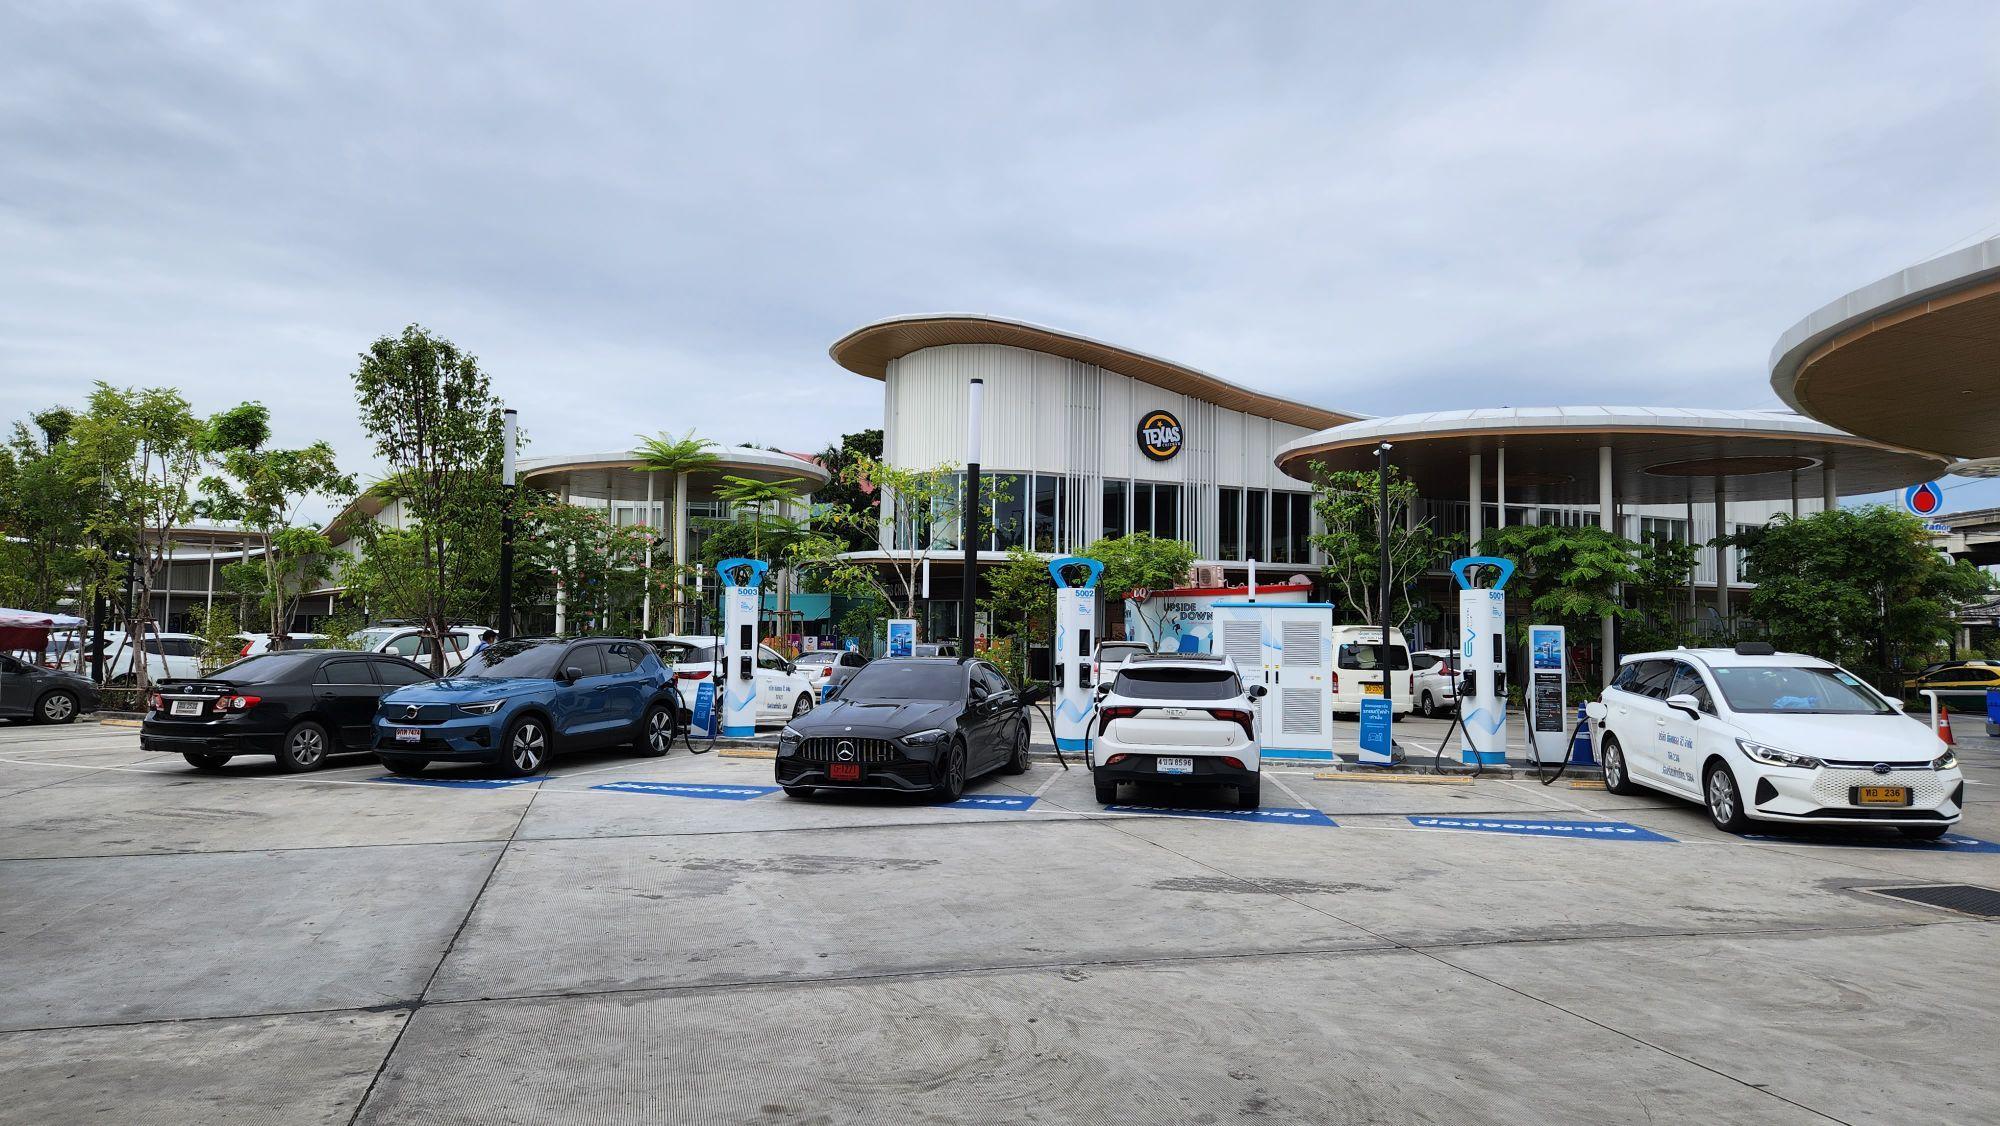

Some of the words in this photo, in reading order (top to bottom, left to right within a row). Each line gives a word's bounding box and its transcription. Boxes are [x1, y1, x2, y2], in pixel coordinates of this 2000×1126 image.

[1143, 426, 1180, 447] TEXAS
[1164, 602, 1197, 612] UPSIDE
[1180, 611, 1214, 620] DOWN
[1174, 759, 1191, 767] 8596
[1884, 789, 1900, 797] 236
